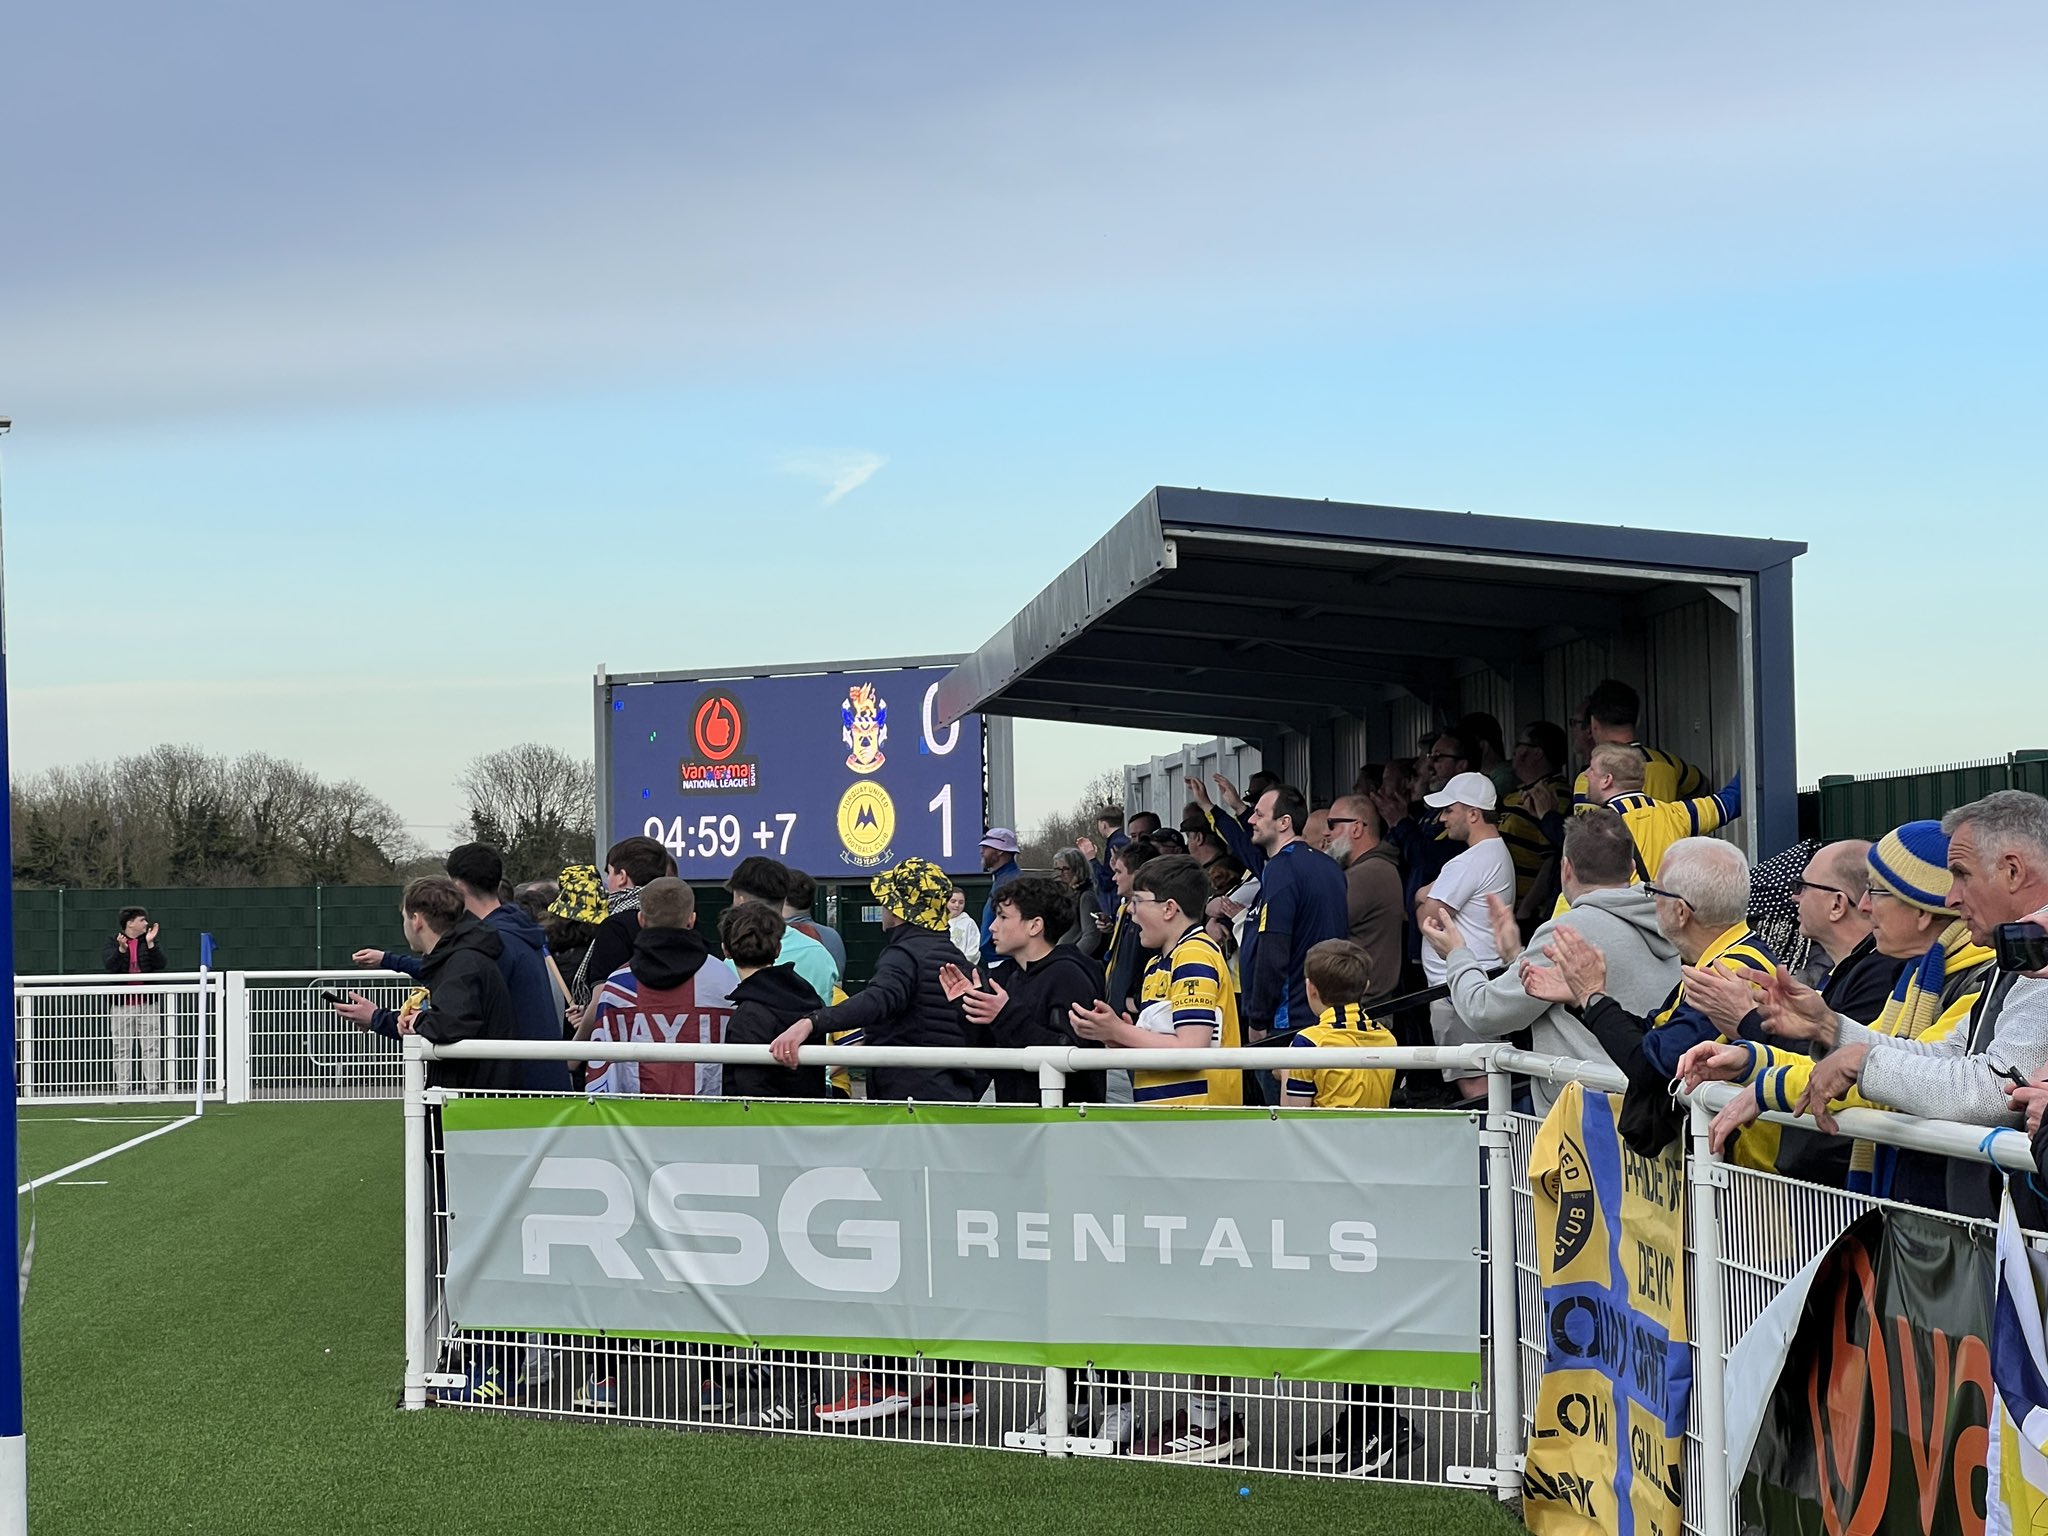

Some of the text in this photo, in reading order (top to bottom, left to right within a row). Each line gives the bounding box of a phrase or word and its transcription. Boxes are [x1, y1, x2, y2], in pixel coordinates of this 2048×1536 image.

[923, 682, 960, 755] 0
[682, 778, 748, 789] NATIONAL LEAGUE
[843, 786, 889, 810] TORQUAY UNITED
[644, 813, 797, 857] 94:59 +7
[844, 832, 889, 854] FOOTBALL CLUB
[929, 783, 952, 857] 1
[521, 1156, 1379, 1293] RSG RENTALS
[1554, 1206, 1587, 1258] CLUB
